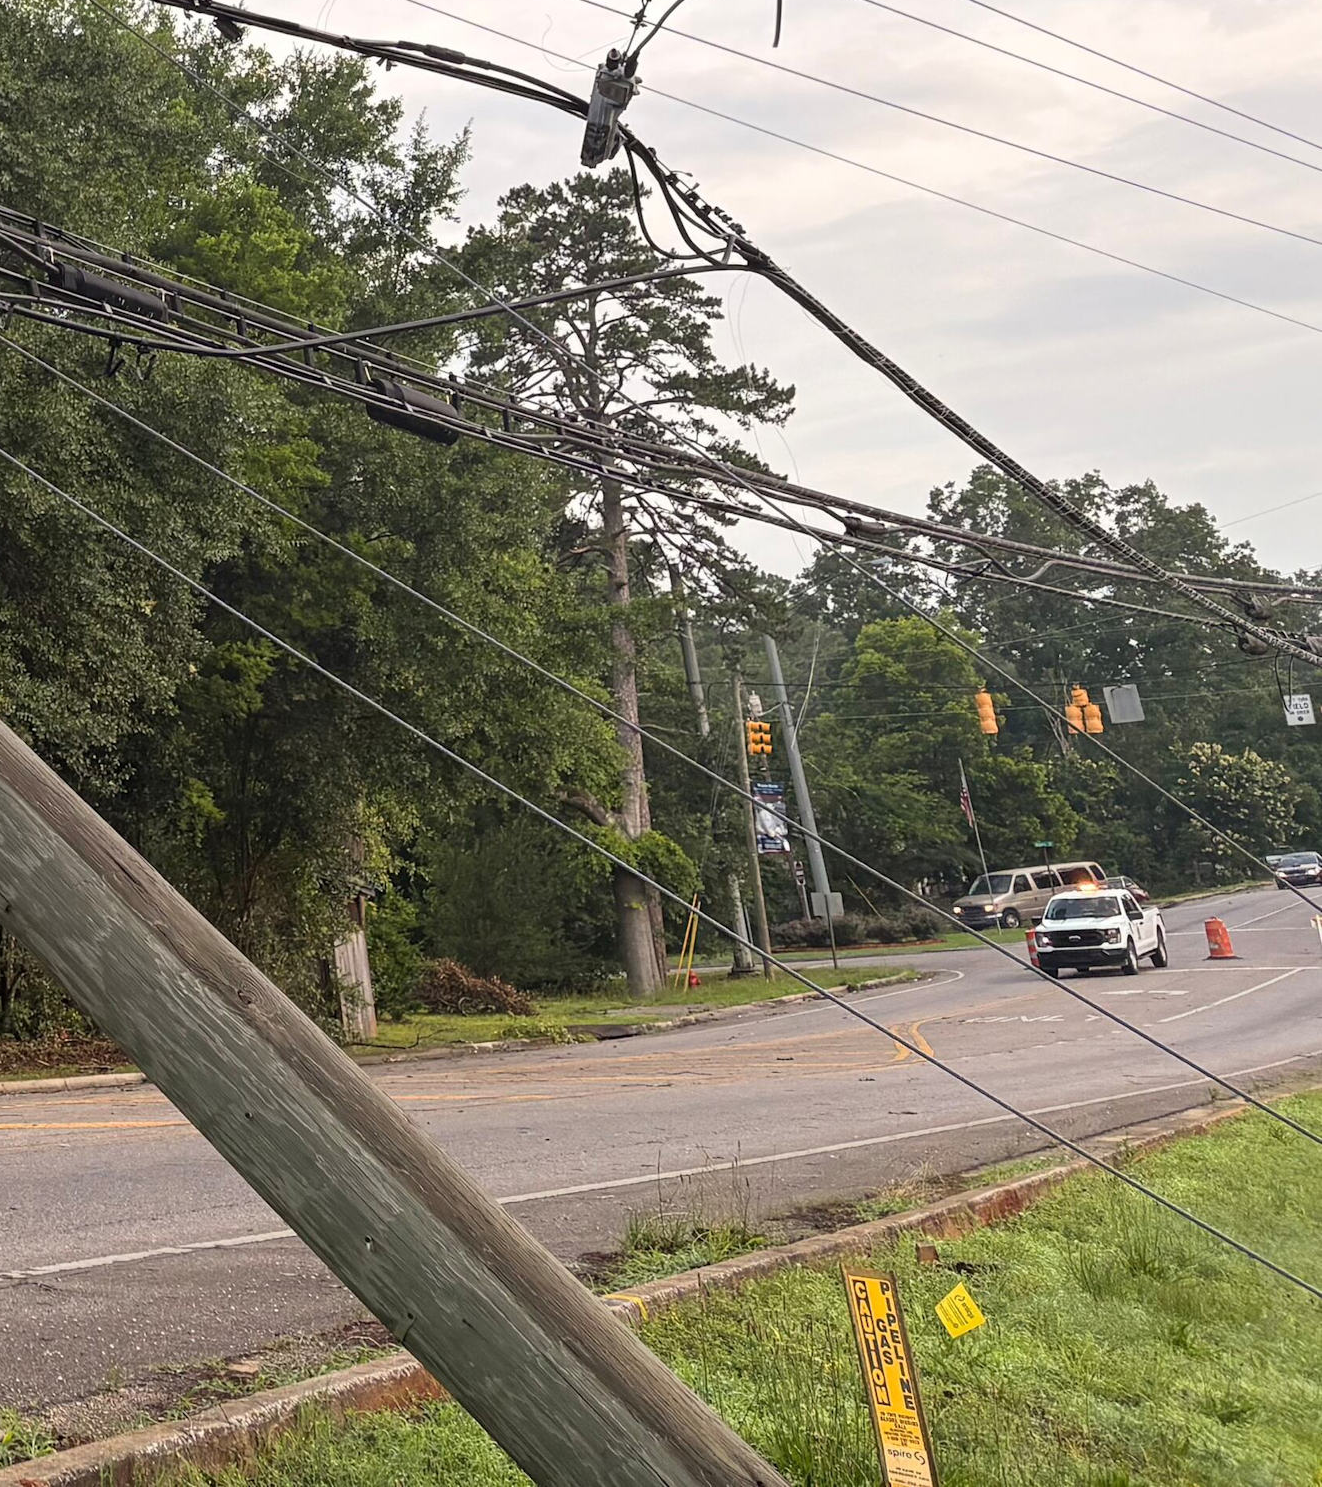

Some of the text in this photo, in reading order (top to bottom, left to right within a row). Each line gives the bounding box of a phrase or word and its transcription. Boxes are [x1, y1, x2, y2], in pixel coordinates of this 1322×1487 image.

[853, 1281, 890, 1405] CAUTION
[876, 1318, 894, 1365] GAS
[880, 1281, 916, 1411] PIPELINE
